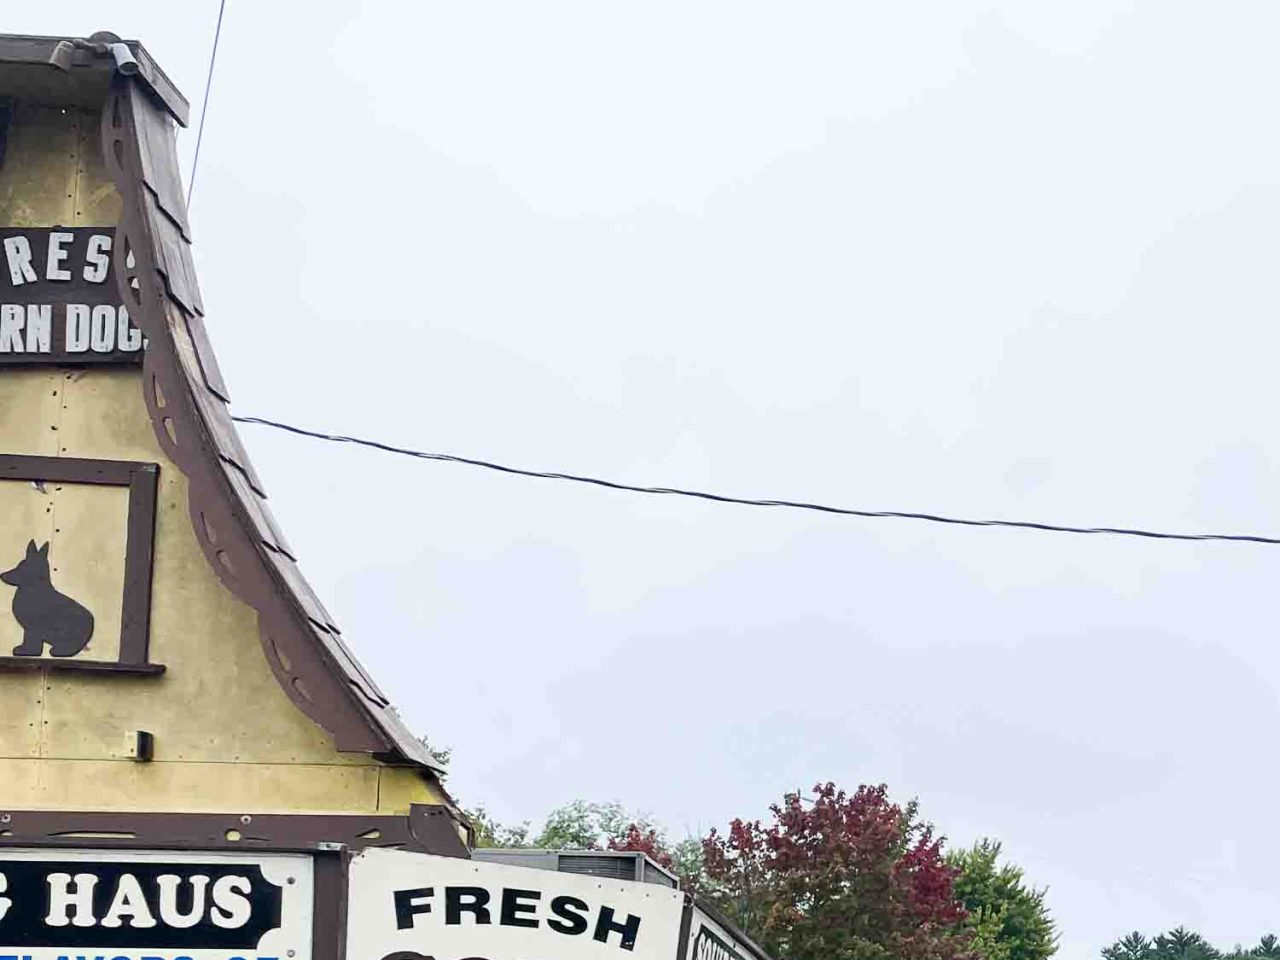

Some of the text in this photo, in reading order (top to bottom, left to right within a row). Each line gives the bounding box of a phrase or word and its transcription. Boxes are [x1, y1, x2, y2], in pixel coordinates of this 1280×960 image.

[65, 304, 149, 353] DOG
[45, 873, 251, 928] HAUS
[394, 886, 641, 951] FRESH
